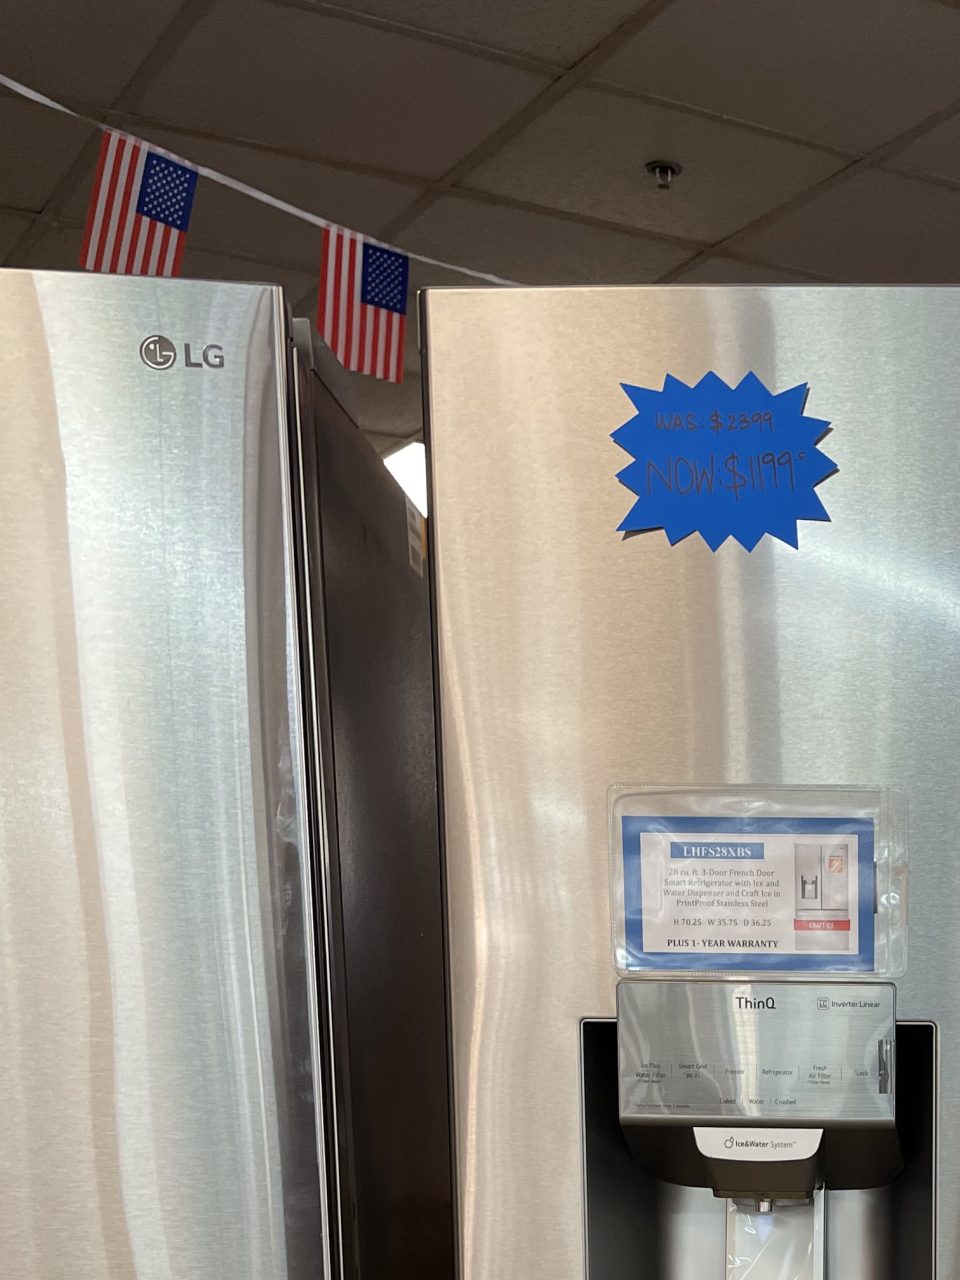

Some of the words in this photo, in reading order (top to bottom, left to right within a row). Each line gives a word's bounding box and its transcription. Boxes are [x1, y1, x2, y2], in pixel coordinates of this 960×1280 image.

[184, 343, 224, 368] LG
[646, 453, 723, 496] NOW:
[683, 846, 752, 857] LHFS28XBS
[702, 868, 727, 877] 3-Door
[729, 869, 754, 877] French
[756, 869, 775, 877] Door
[664, 878, 686, 887] Smart
[688, 878, 733, 888] Refrigerator
[735, 879, 752, 887] with
[753, 879, 764, 887] Ice
[765, 879, 780, 887] and
[663, 889, 685, 897] Water
[687, 889, 724, 899] Dispenser
[725, 889, 740, 897] and
[741, 888, 759, 897] Craft
[761, 889, 772, 897] Ice
[676, 899, 715, 907] PrintProof
[716, 899, 749, 907] Stainless
[750, 900, 768, 908] Steel
[673, 918, 680, 926] H
[681, 918, 702, 926] 70.25
[707, 918, 716, 926] W
[717, 918, 738, 926] 35.75
[750, 919, 772, 927] 36.25
[667, 939, 690, 947] PLUS
[702, 940, 725, 948] YEAR
[726, 940, 779, 948] WARRANTY
[735, 996, 777, 1010] ThinQ
[859, 1001, 881, 1009] Linear
[761, 1069, 793, 1077] Refrigerator
[735, 1140, 769, 1148] Ice&Water
